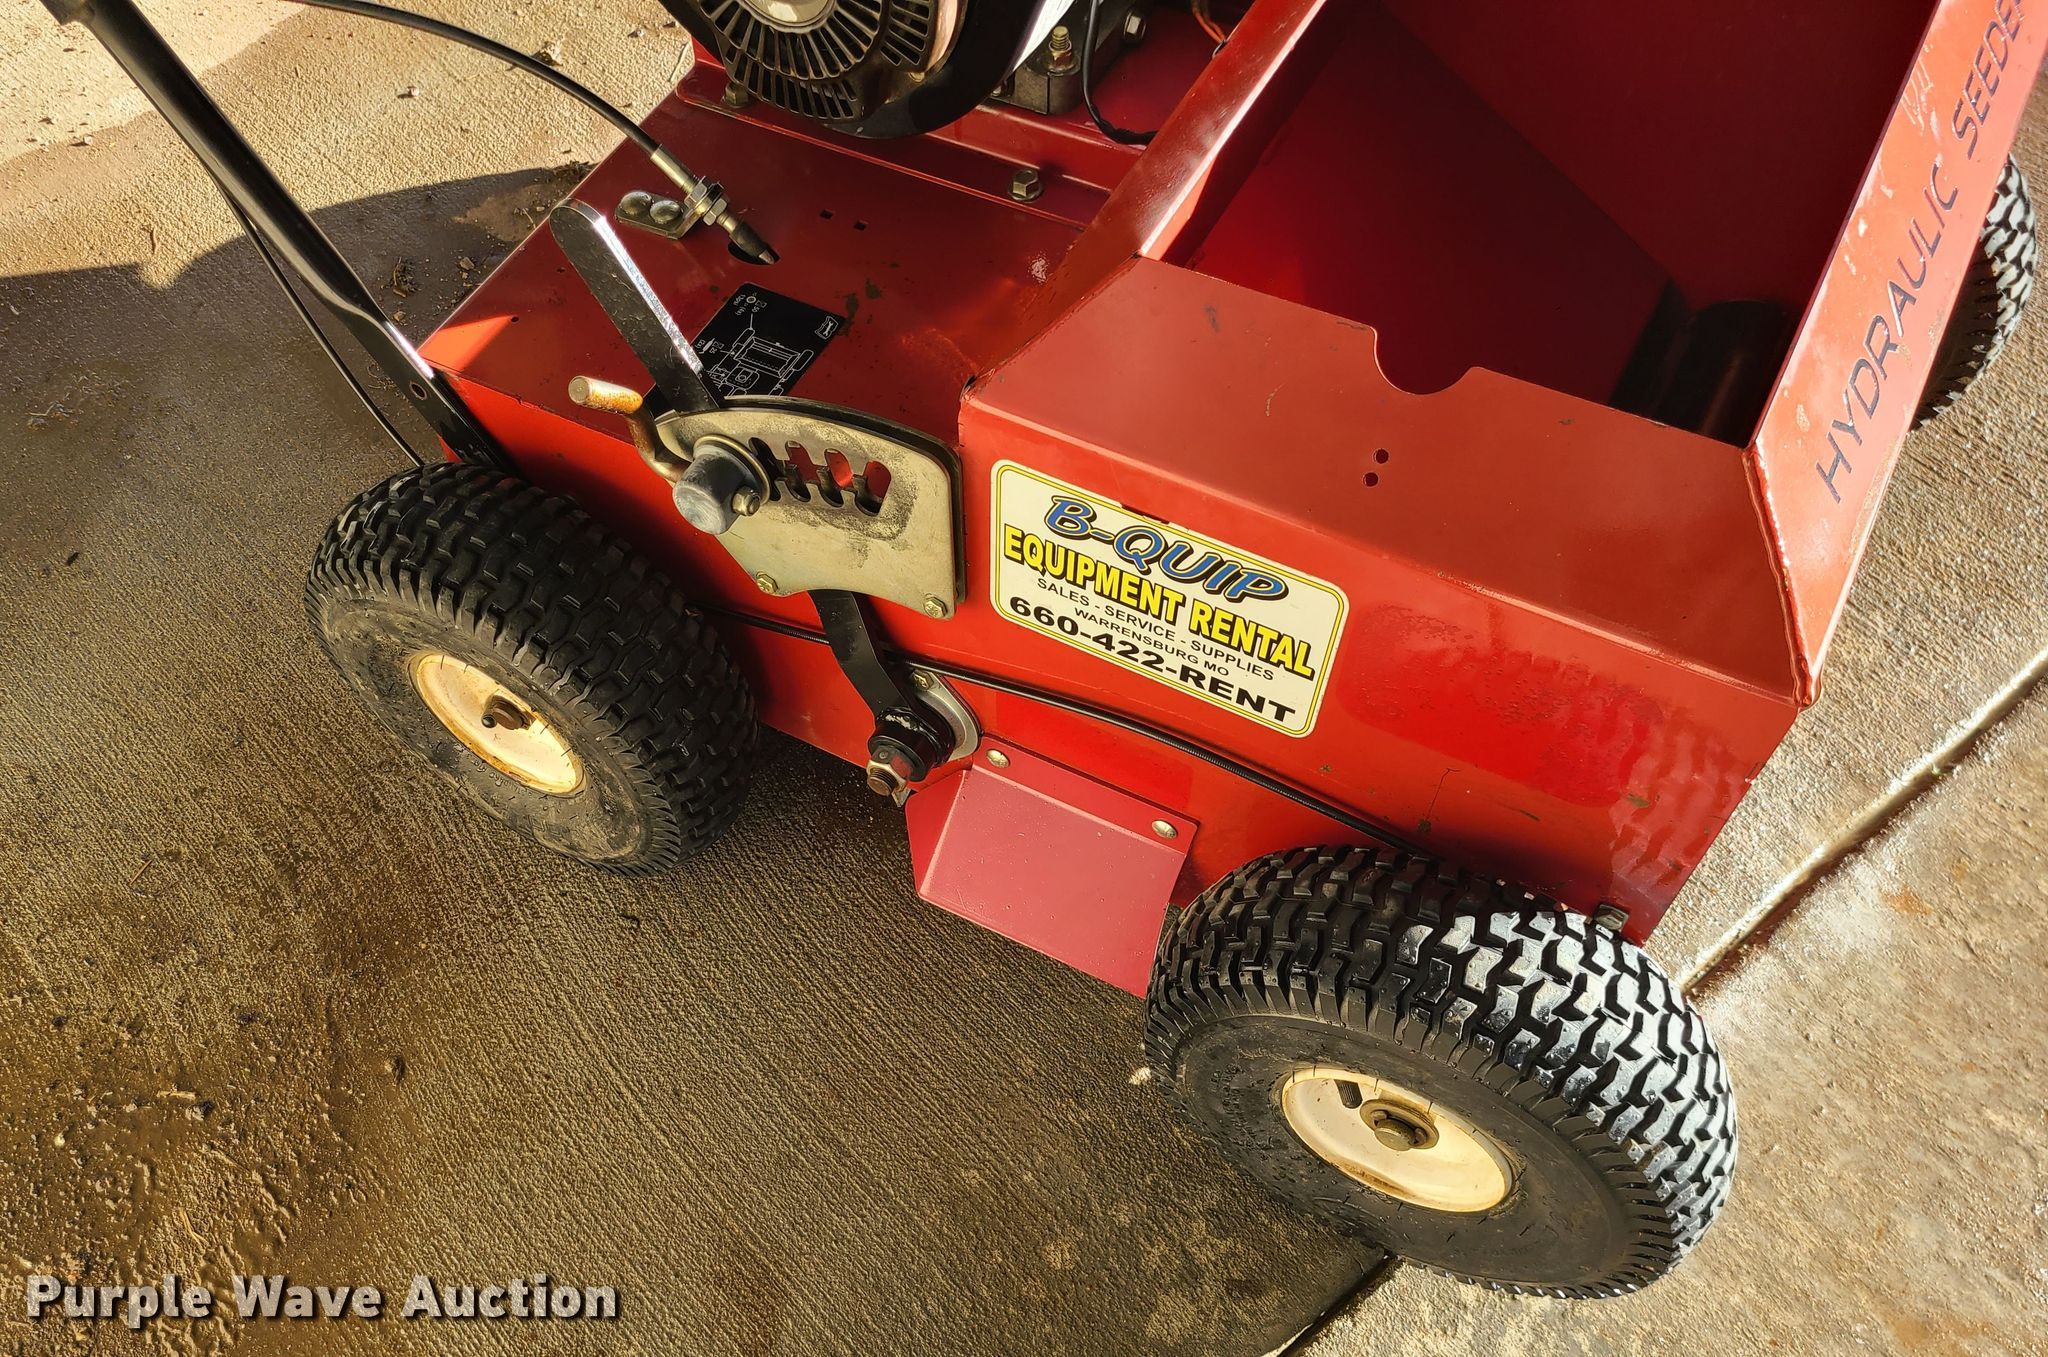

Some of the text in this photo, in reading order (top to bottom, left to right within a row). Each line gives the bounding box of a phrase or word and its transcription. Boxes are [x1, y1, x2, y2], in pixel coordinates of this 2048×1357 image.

[1815, 0, 2022, 504] HYDRAULIC SEEDE
[1003, 523, 1316, 681] EQUIPMENT RENTAL
[1043, 495, 1288, 603] B-QUIP
[1009, 596, 1296, 723] 660-422-RENT
[1037, 577, 1090, 608] SALES
[1104, 603, 1176, 643] SERVICE
[1189, 639, 1274, 682] SUPPLIES
[1073, 606, 1230, 677] WARRENSBURG MO
